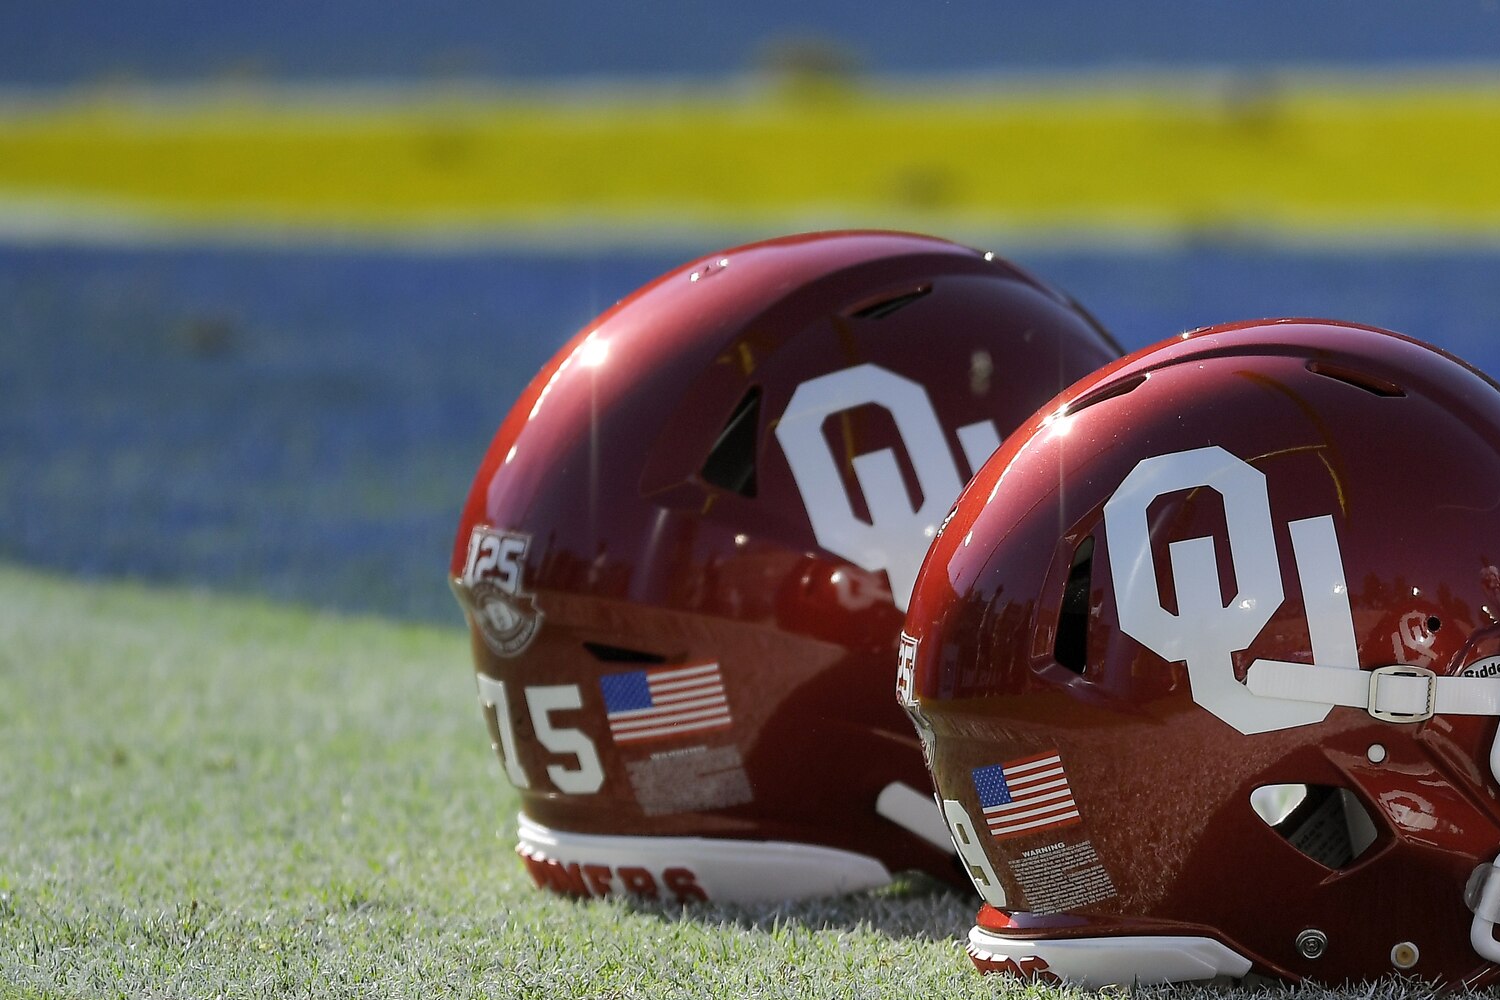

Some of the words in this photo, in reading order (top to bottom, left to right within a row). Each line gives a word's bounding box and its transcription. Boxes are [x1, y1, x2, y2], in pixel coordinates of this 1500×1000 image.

[464, 532, 525, 595] 125
[1102, 446, 1359, 735] OU
[476, 672, 605, 794] 75
[1021, 841, 1066, 859] WARNING
